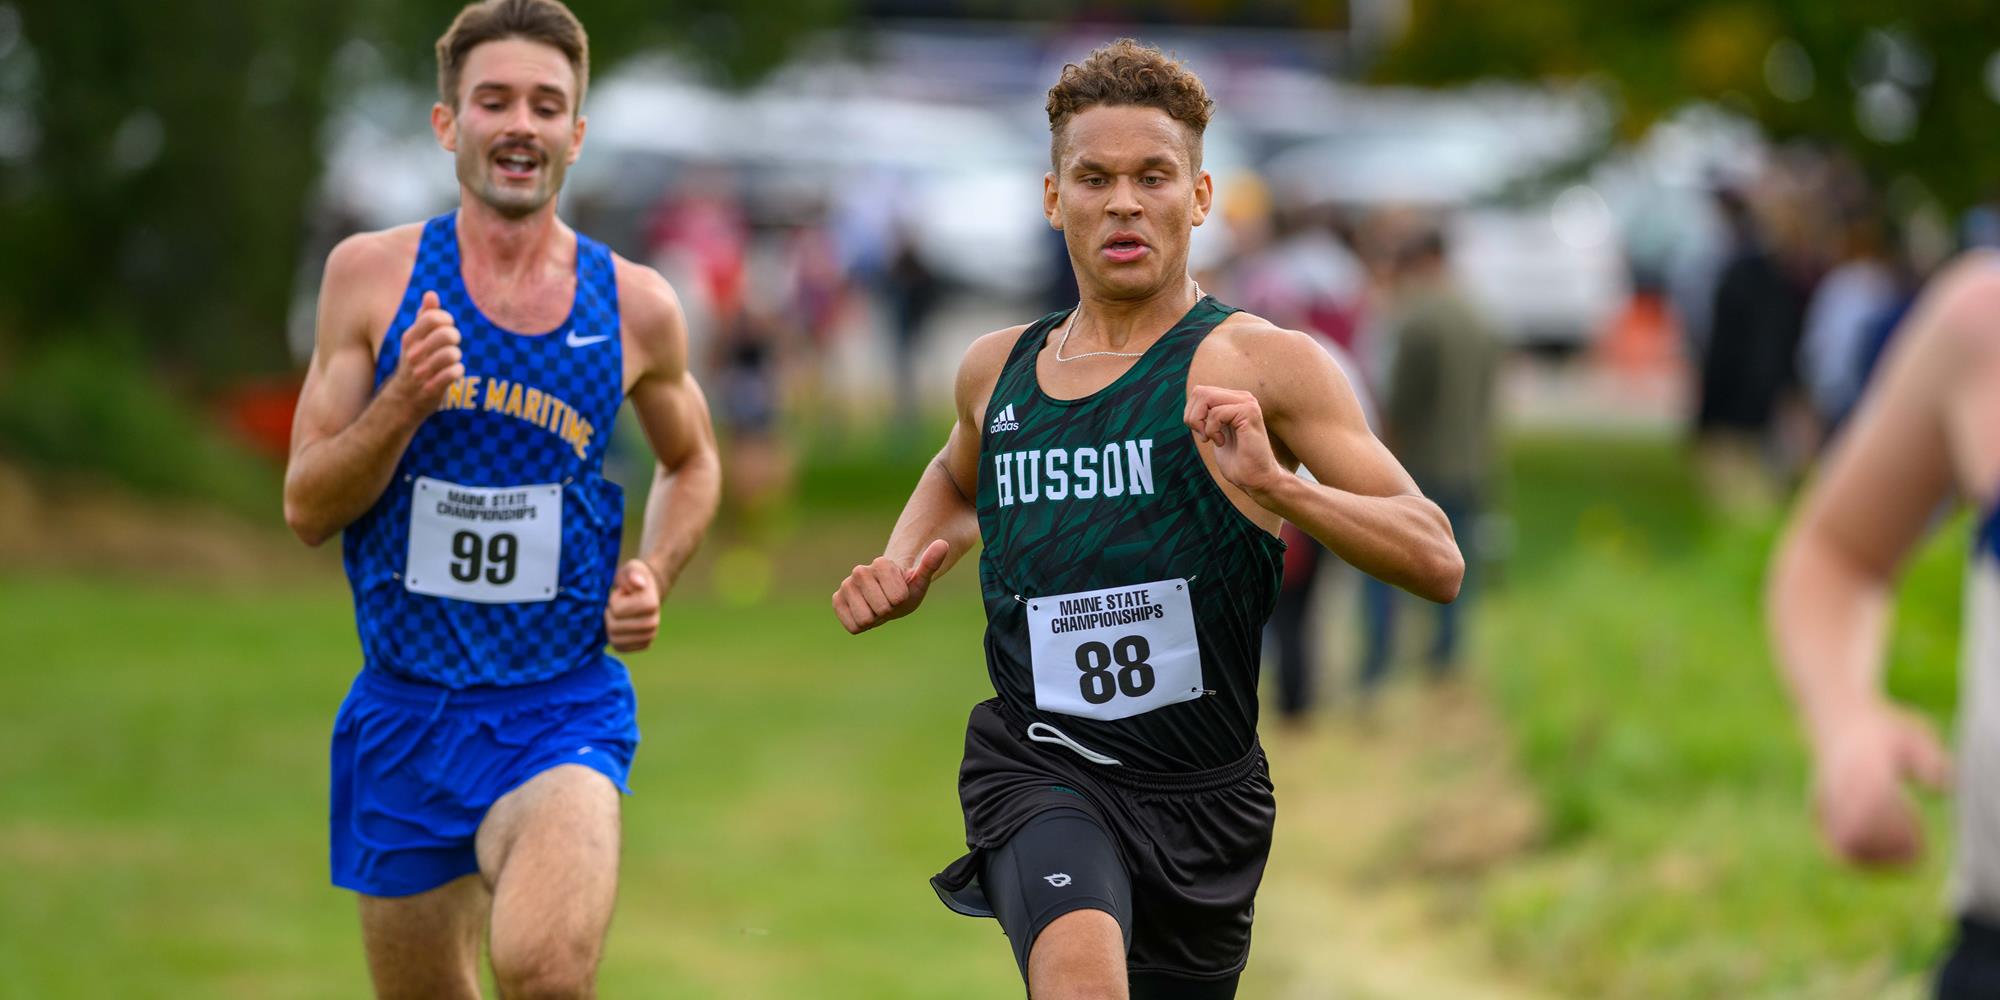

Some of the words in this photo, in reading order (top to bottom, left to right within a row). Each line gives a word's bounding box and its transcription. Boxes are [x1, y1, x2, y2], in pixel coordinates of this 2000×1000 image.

[439, 375, 482, 411] NE
[483, 376, 595, 461] MARITIME
[990, 420, 1019, 434] adidas
[995, 438, 1155, 508] HUSSON
[450, 529, 519, 585] 99
[1051, 603, 1164, 634] CHAMPIONSHIPS
[1059, 595, 1103, 616] MAINE
[1107, 589, 1150, 612] STATE
[1075, 634, 1156, 704] 88
